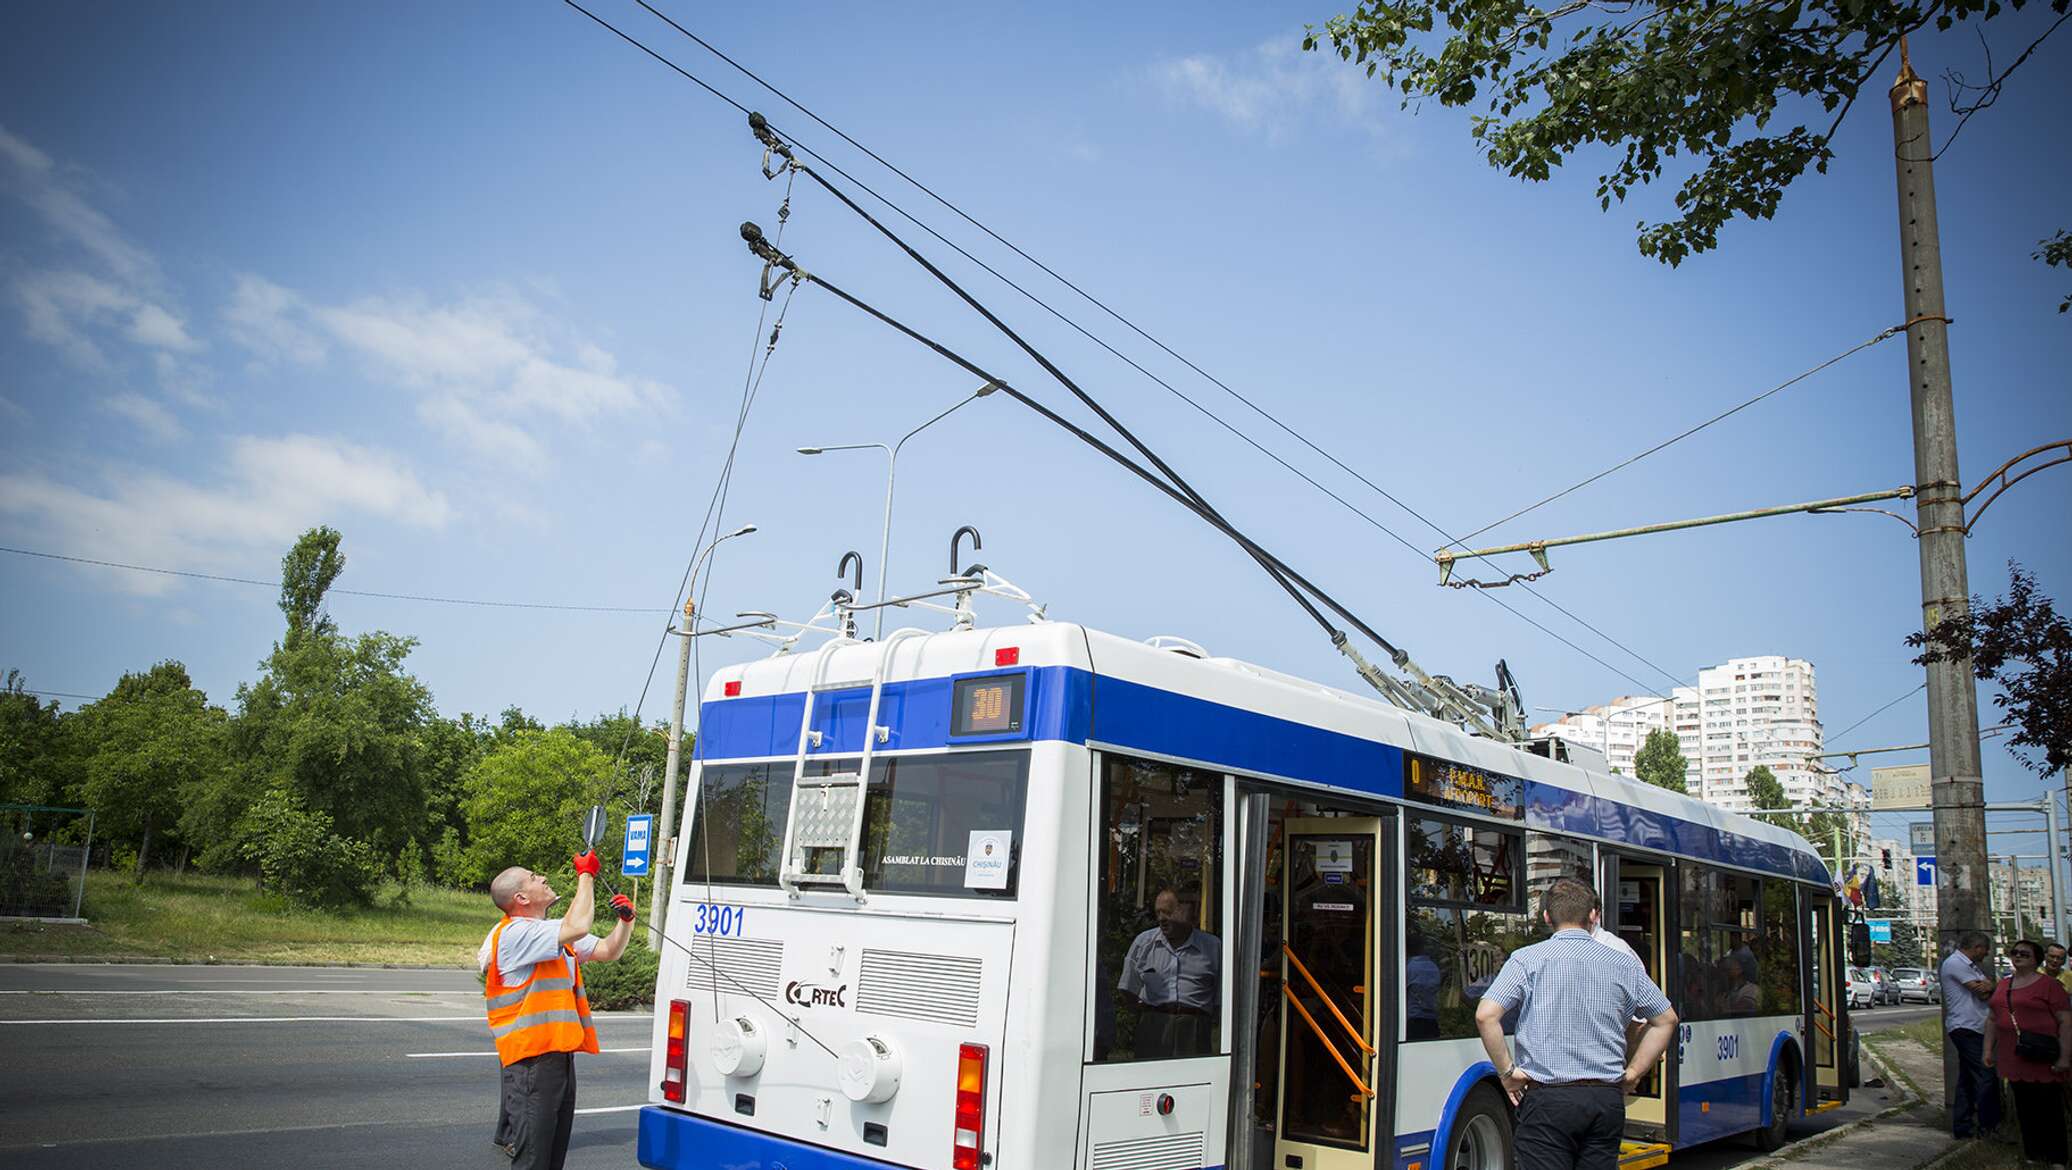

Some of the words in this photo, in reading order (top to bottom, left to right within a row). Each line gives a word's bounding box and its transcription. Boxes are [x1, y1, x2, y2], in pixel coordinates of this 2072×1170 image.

[971, 687, 1002, 720] 30
[882, 855, 919, 865] ASAMBLAT
[920, 857, 930, 865] LA
[694, 903, 745, 937] 3901
[1717, 1034, 1739, 1060] 3901
